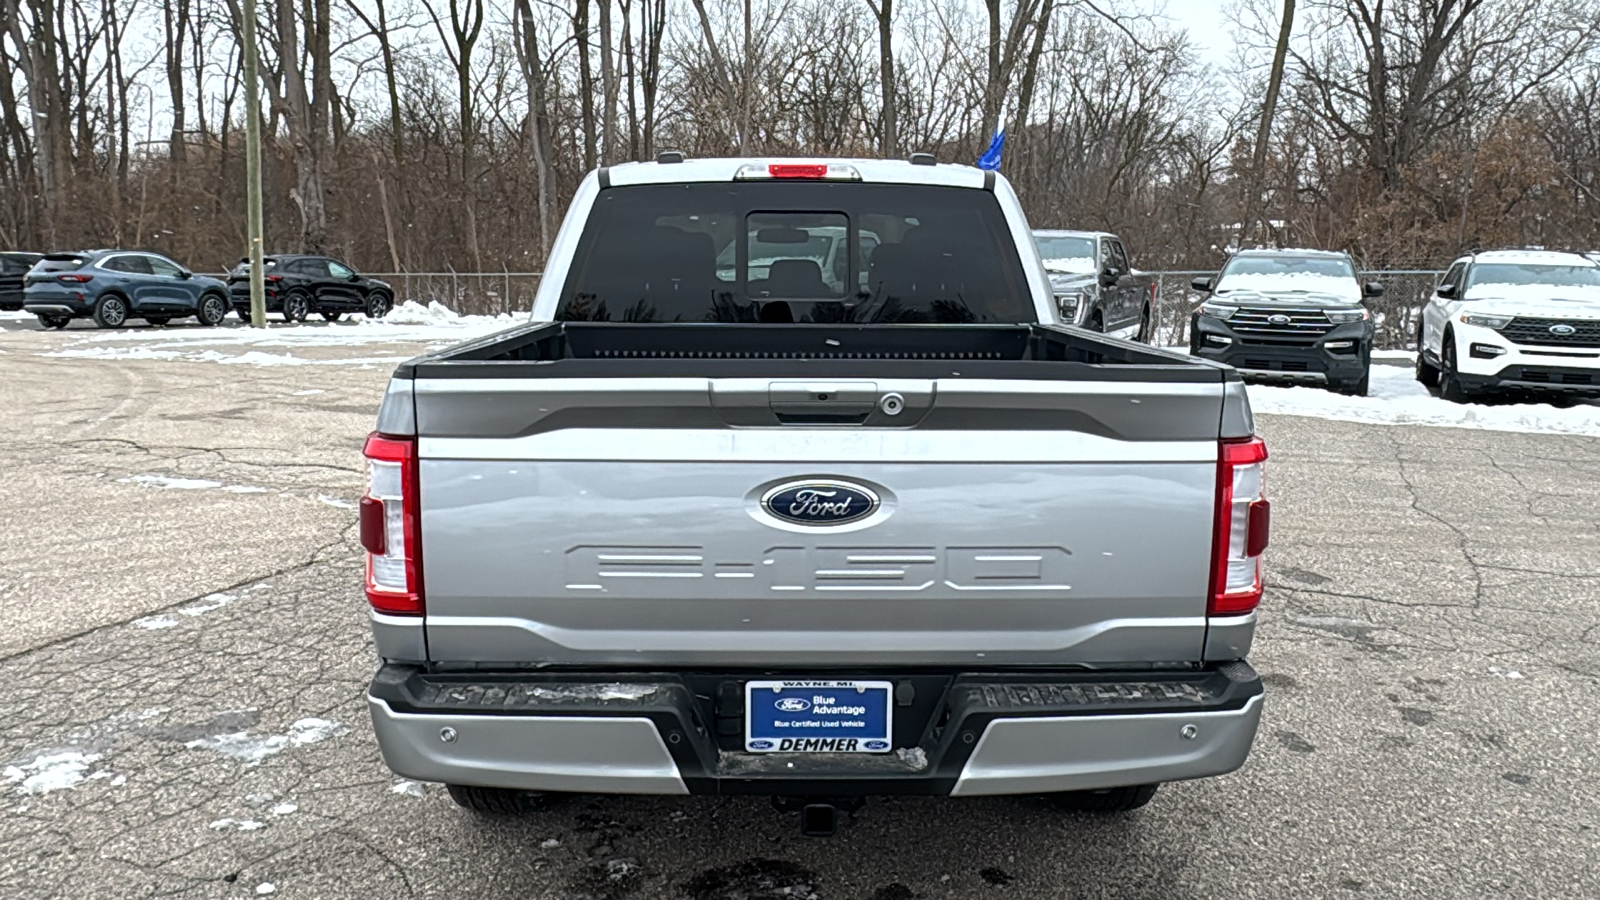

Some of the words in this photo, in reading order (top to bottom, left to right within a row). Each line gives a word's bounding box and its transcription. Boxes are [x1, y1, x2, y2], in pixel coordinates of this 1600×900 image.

[789, 489, 852, 516] Ford
[565, 545, 1073, 592] F-150
[780, 699, 804, 710] Ford
[813, 695, 836, 705] Blue
[812, 705, 866, 716] Advantage
[774, 720, 790, 728] Blue
[791, 720, 820, 728] Certified
[821, 720, 840, 728] Used
[841, 720, 866, 728] Vehicle
[779, 738, 859, 752] DEMMER
